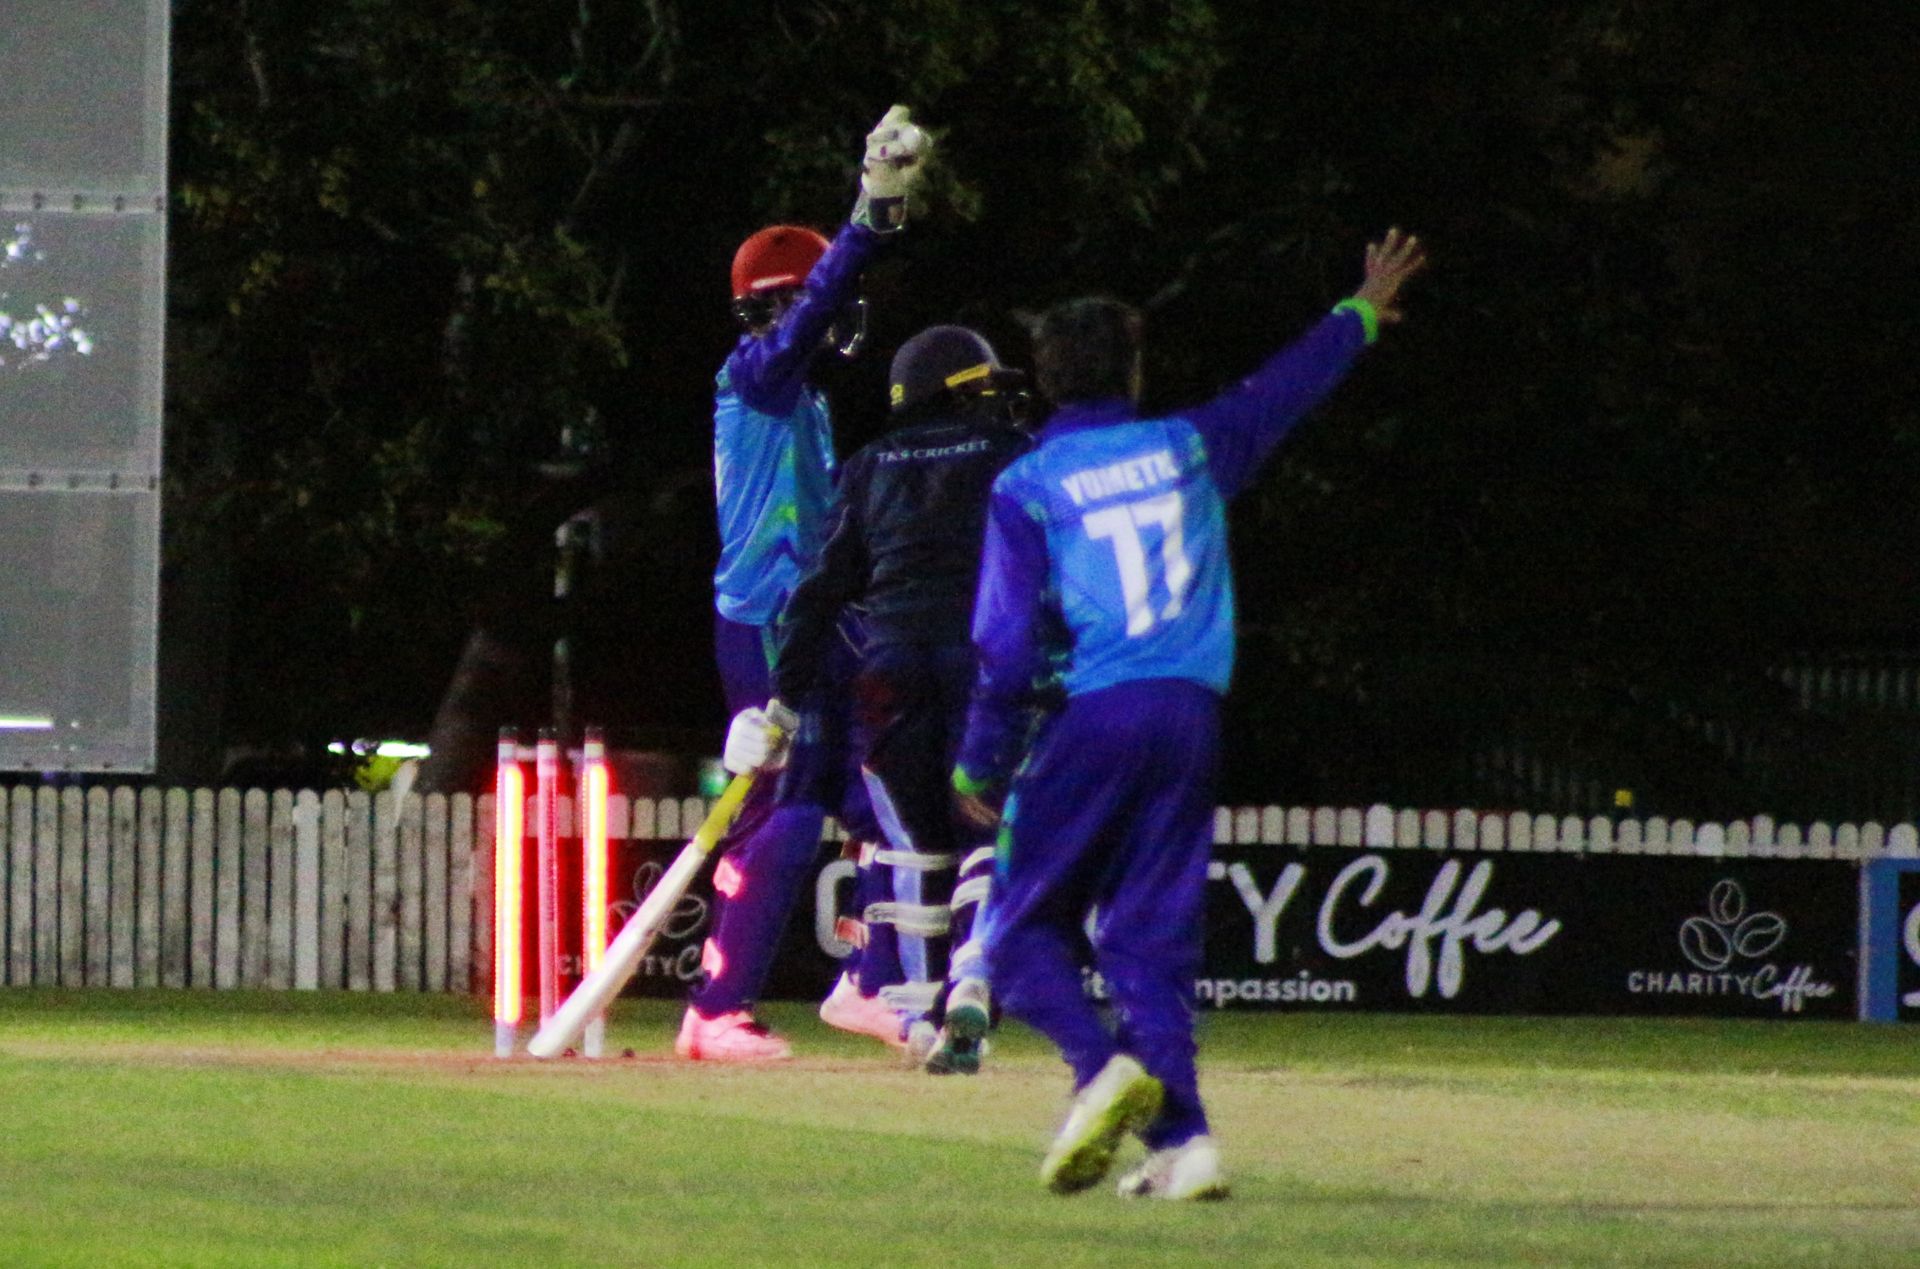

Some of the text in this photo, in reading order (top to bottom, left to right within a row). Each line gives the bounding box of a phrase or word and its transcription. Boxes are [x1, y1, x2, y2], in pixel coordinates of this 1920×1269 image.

[1316, 854, 1561, 998] Coffee
[1627, 963, 1836, 1012] CHARITY Coffee
